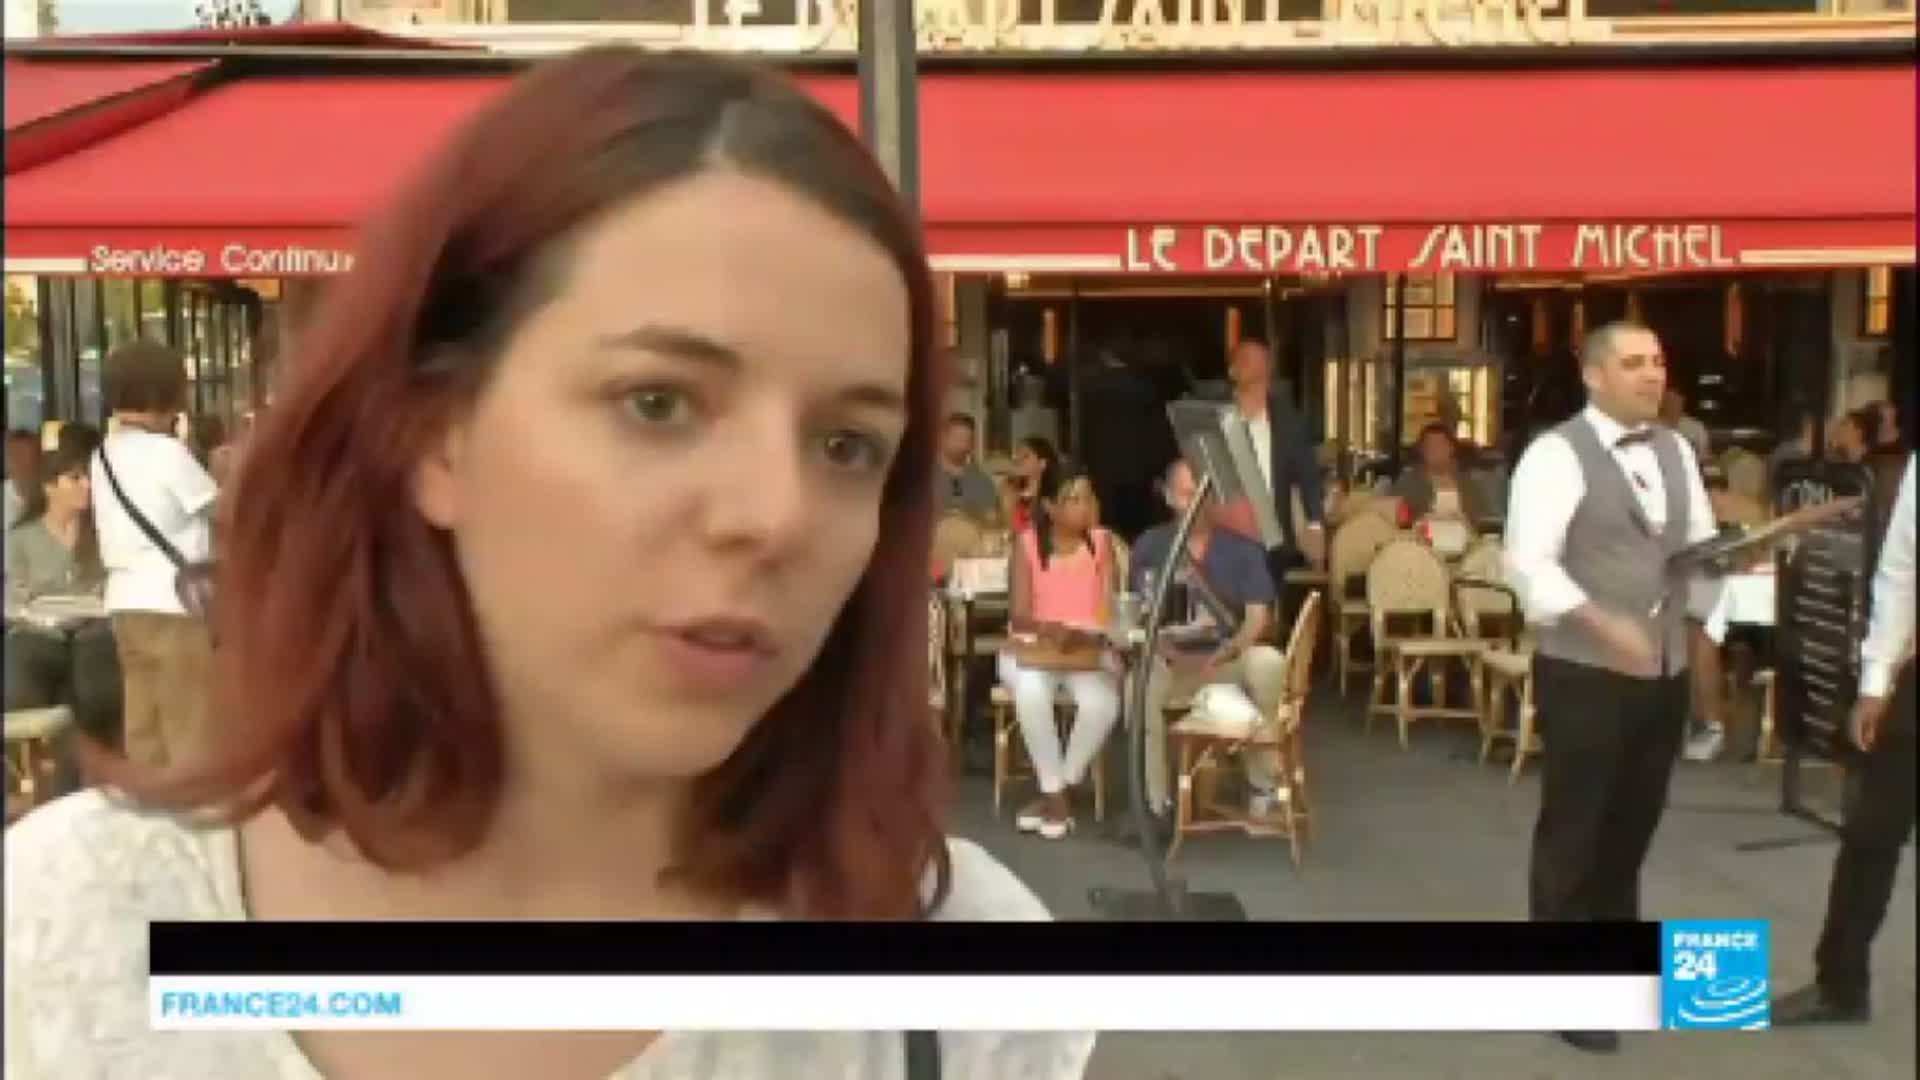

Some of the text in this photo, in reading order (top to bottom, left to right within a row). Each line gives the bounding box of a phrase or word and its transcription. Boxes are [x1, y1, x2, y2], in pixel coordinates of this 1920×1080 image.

[91, 244, 205, 273] Service
[1126, 224, 1736, 272] LE DEPART SAINT MICHEL
